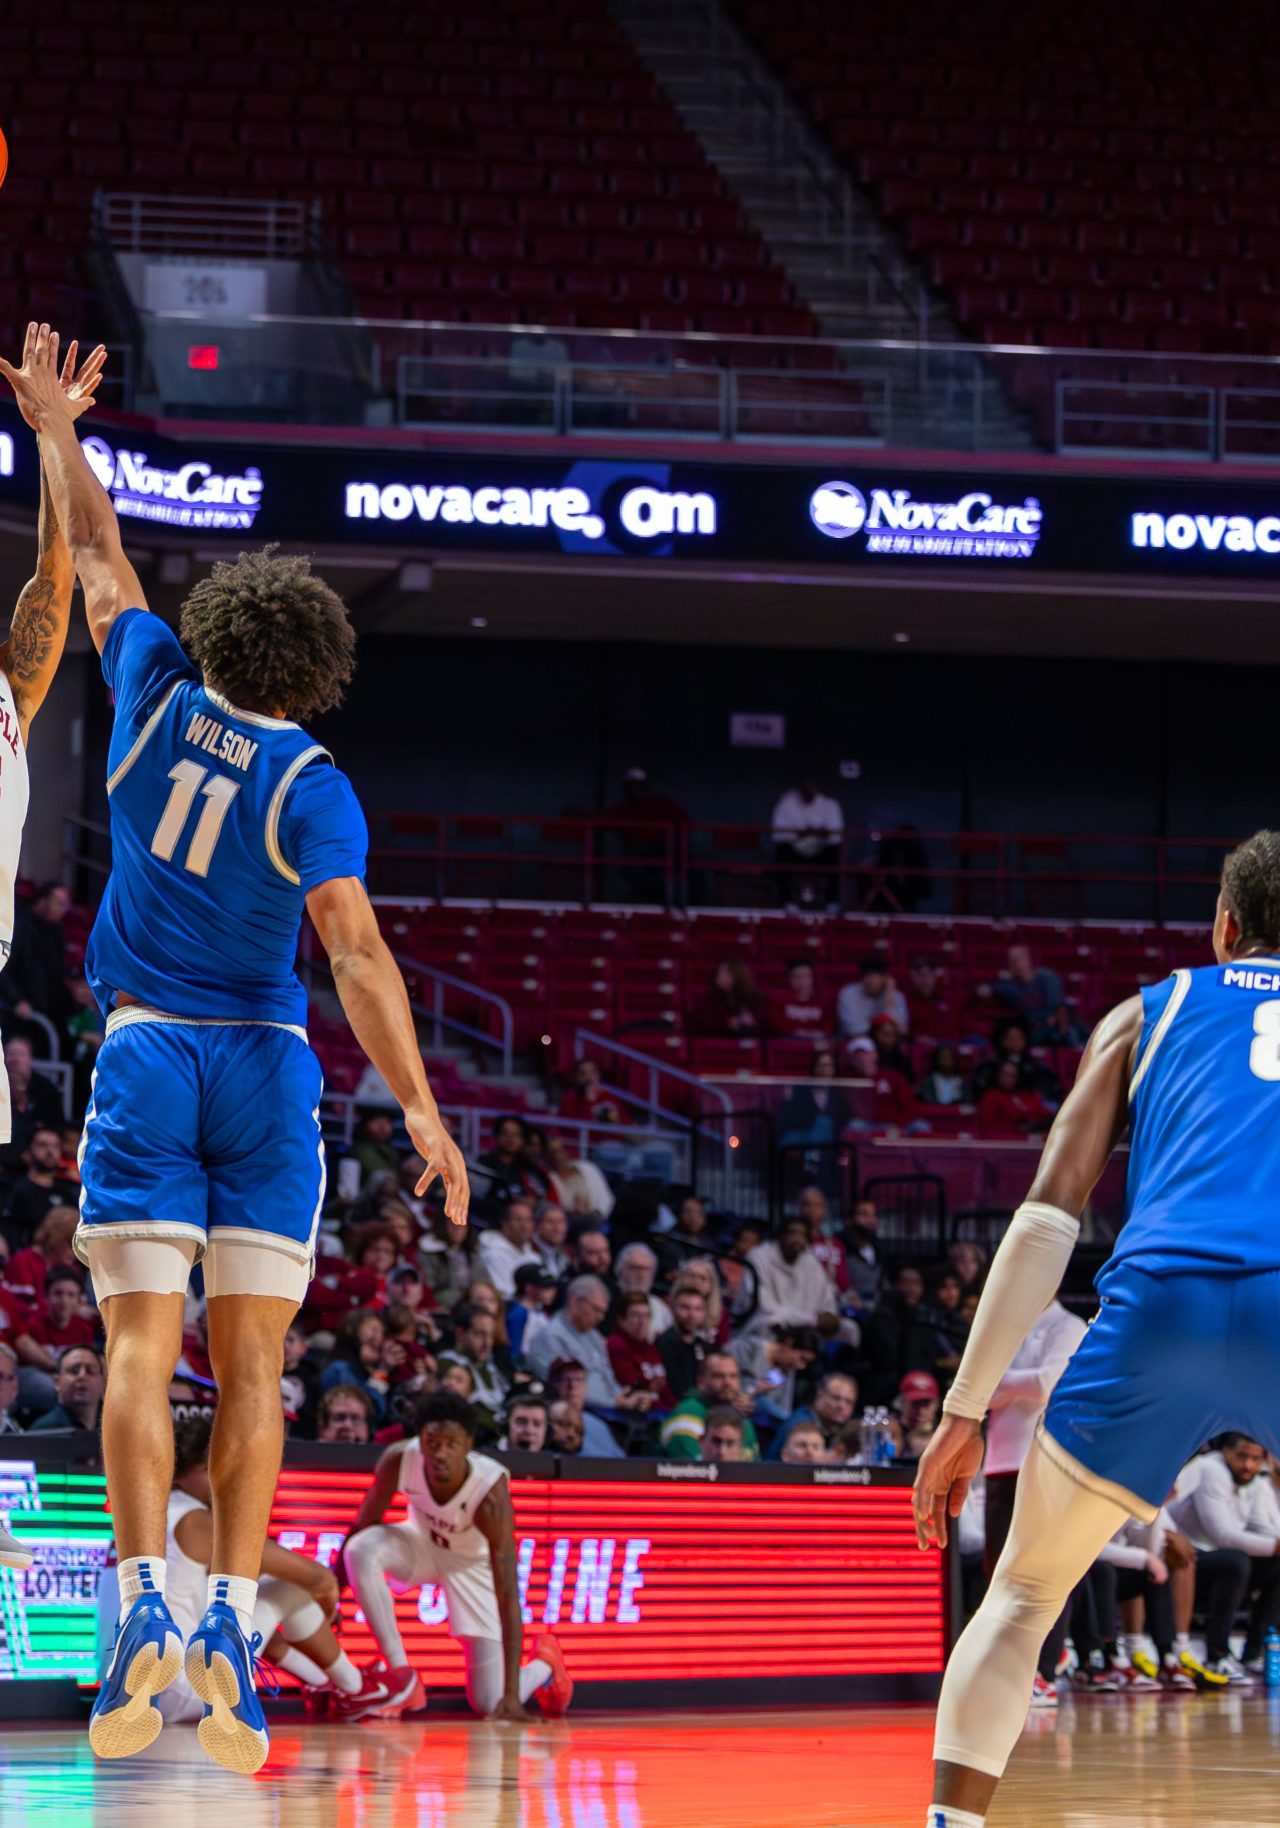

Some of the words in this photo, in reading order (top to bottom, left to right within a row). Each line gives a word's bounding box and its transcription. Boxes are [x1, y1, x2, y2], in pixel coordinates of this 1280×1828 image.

[111, 449, 264, 505] NovaCare
[864, 488, 1043, 534] NovaCare
[185, 711, 259, 773] WILSON
[150, 757, 242, 879] 11
